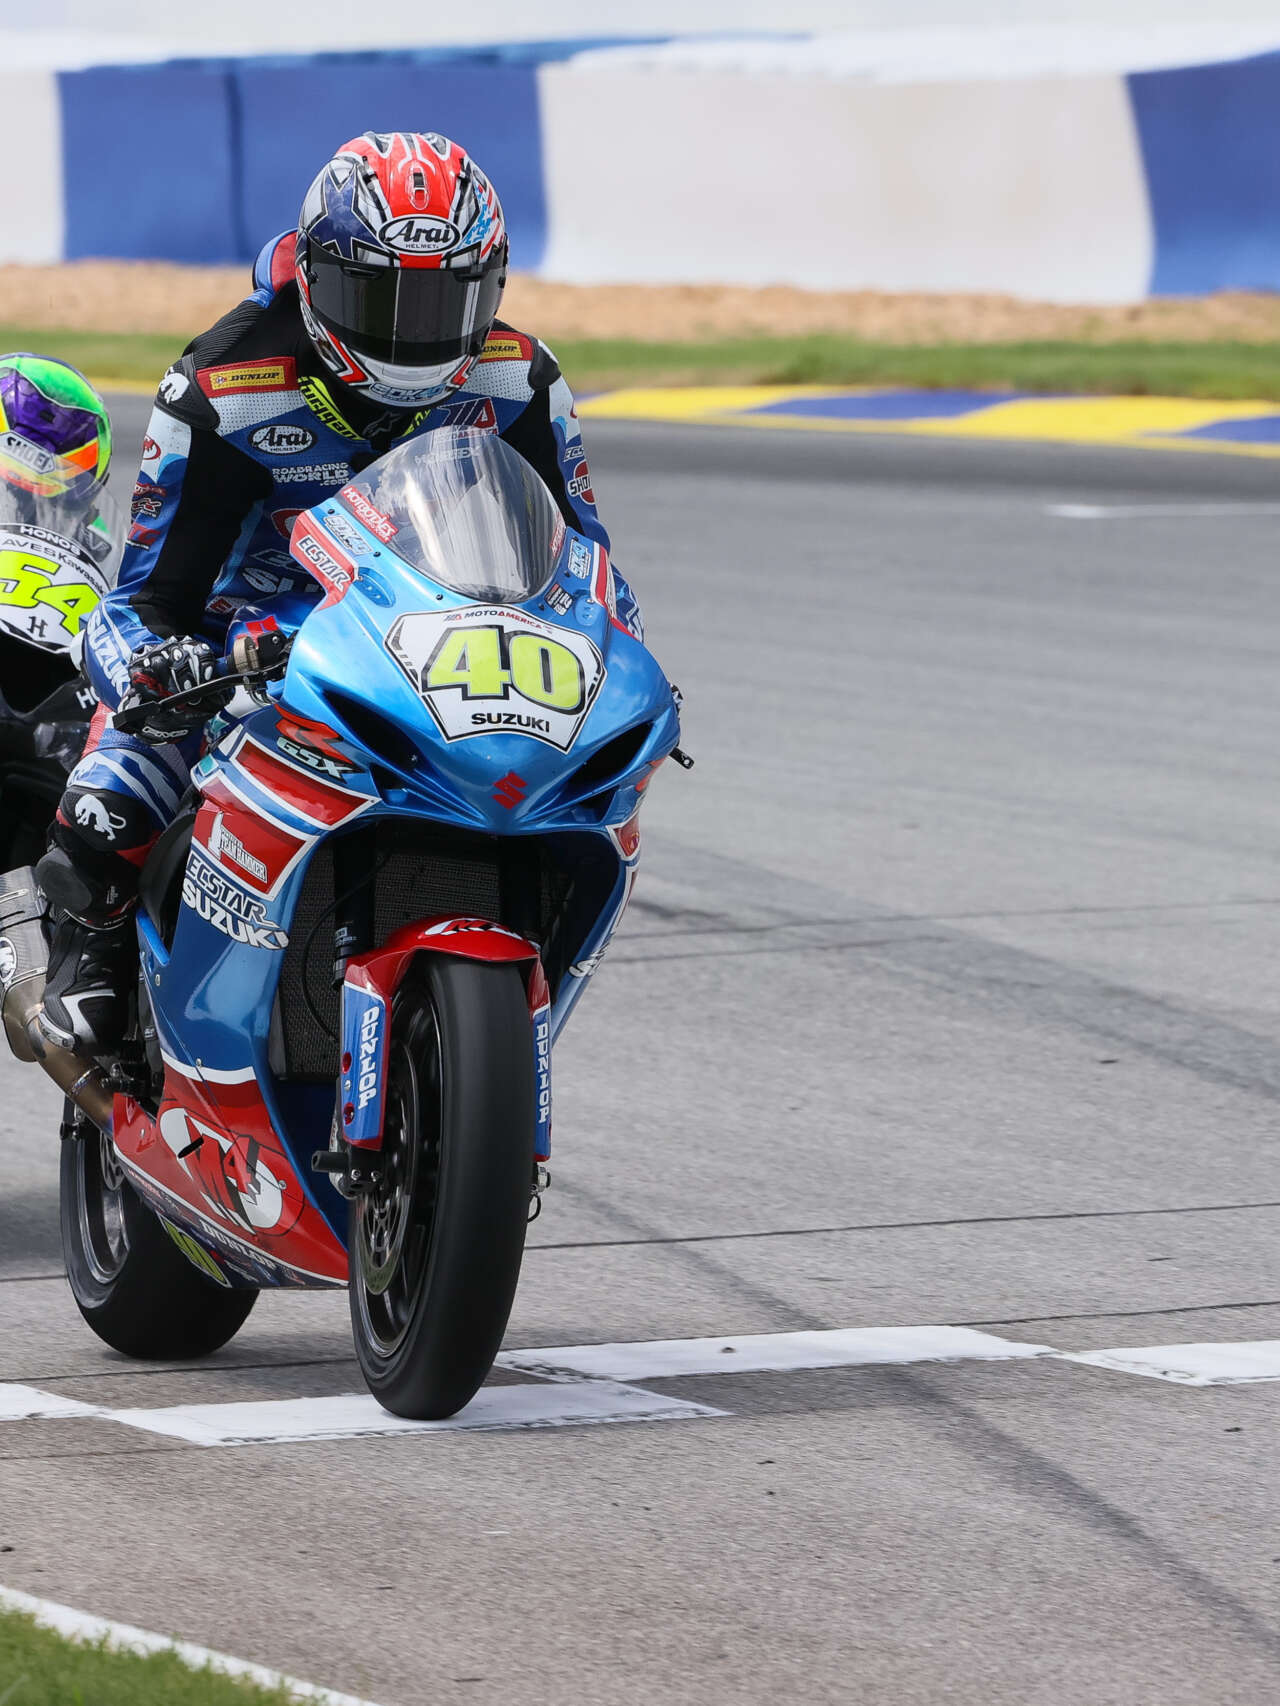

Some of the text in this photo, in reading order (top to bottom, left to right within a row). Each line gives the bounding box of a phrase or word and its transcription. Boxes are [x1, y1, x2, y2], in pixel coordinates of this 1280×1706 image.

[382, 220, 452, 244] Arai
[230, 372, 280, 381] DUNLOP
[253, 427, 310, 446] Arai
[6, 436, 51, 472] SHOEI
[272, 462, 349, 475] ROADRACING
[273, 470, 349, 483] WORLD
[570, 475, 590, 495] SHO
[20, 526, 81, 556] HONOS
[299, 536, 347, 592] ECSTAR
[464, 610, 543, 629] MOTOAMERICA
[423, 625, 584, 714] 40
[471, 712, 550, 734] SUZUKI
[277, 737, 353, 779] GSX
[186, 852, 280, 929] ECSTAR
[182, 878, 289, 950] SUZUKI
[357, 1006, 380, 1110] DUNLOP
[536, 1022, 549, 1124] DUNLOP
